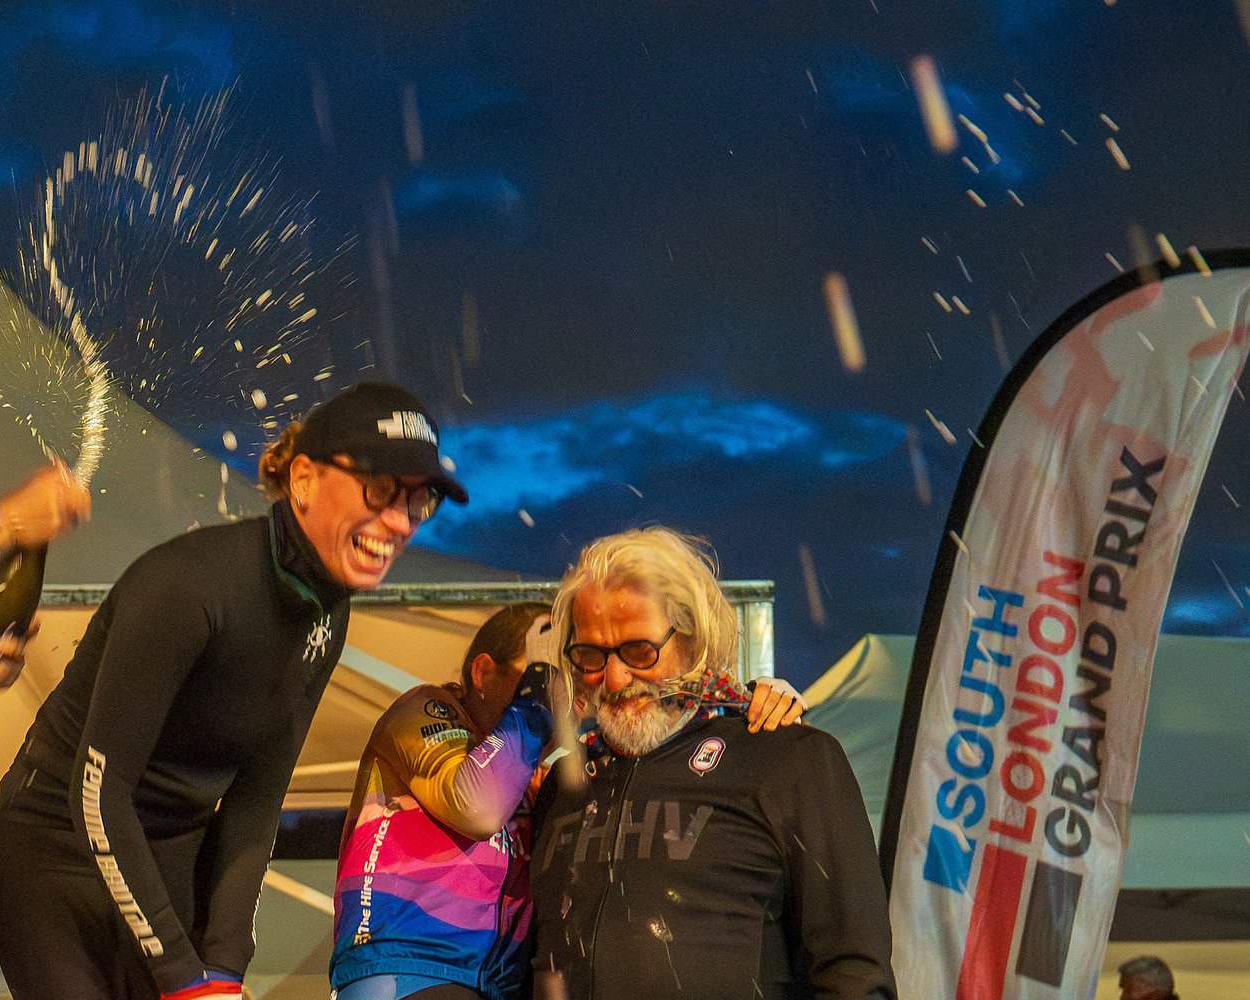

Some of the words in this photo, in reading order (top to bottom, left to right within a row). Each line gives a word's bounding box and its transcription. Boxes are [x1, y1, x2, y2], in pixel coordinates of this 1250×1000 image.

[935, 584, 1024, 829] SOUTH
[988, 551, 1086, 844] LONDON
[1042, 620, 1118, 858] GRAND
[1087, 446, 1167, 613] PRIX
[360, 875, 373, 906] Hire
[364, 819, 390, 873] Service
[357, 908, 371, 934] The
